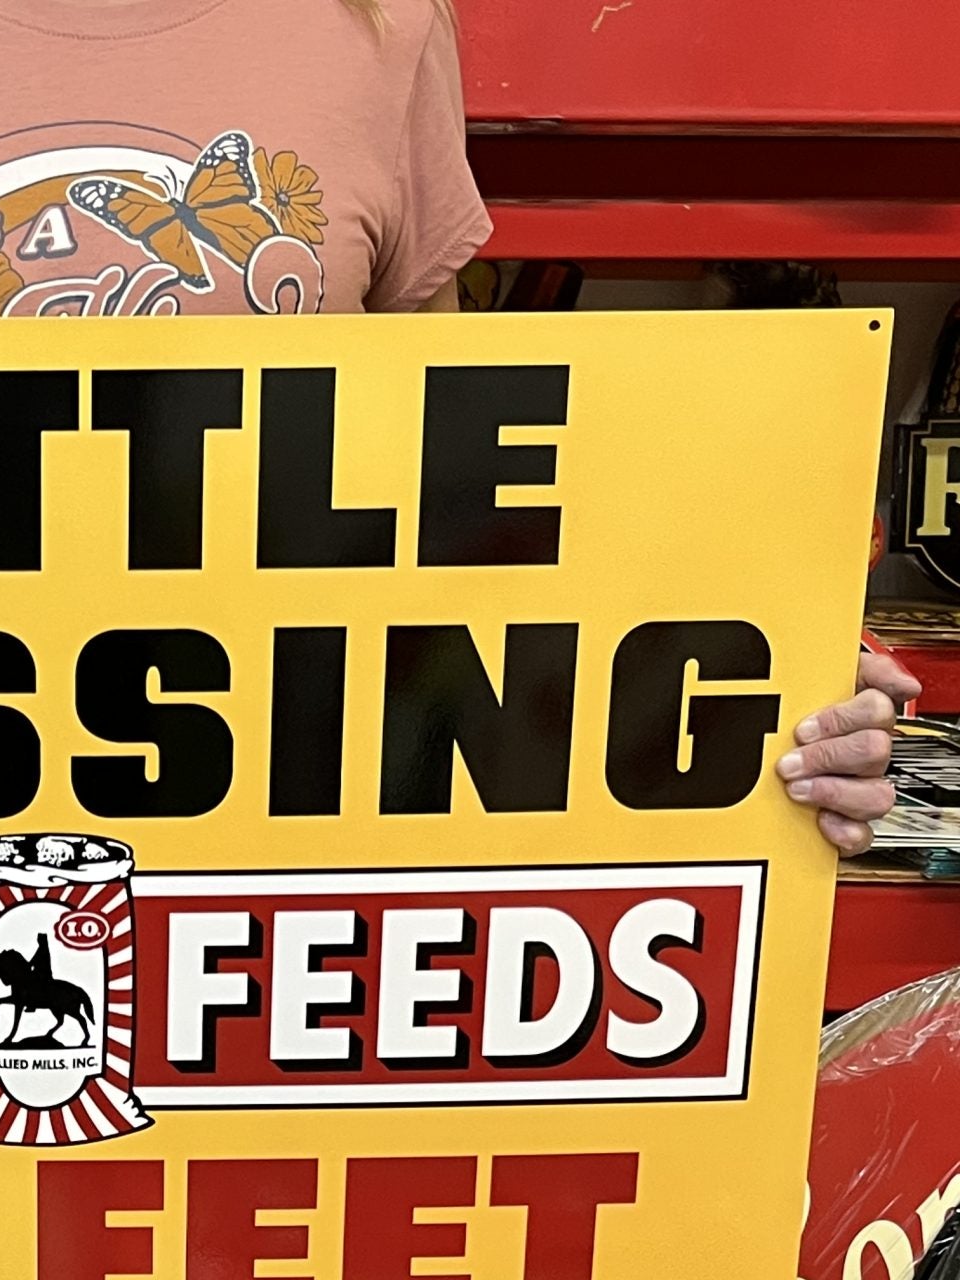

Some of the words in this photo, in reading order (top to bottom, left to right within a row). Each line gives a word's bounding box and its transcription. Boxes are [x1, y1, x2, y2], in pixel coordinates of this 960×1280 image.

[16, 205, 77, 262] A
[166, 897, 713, 1076] FEEDS
[73, 1056, 99, 1069] INC.
